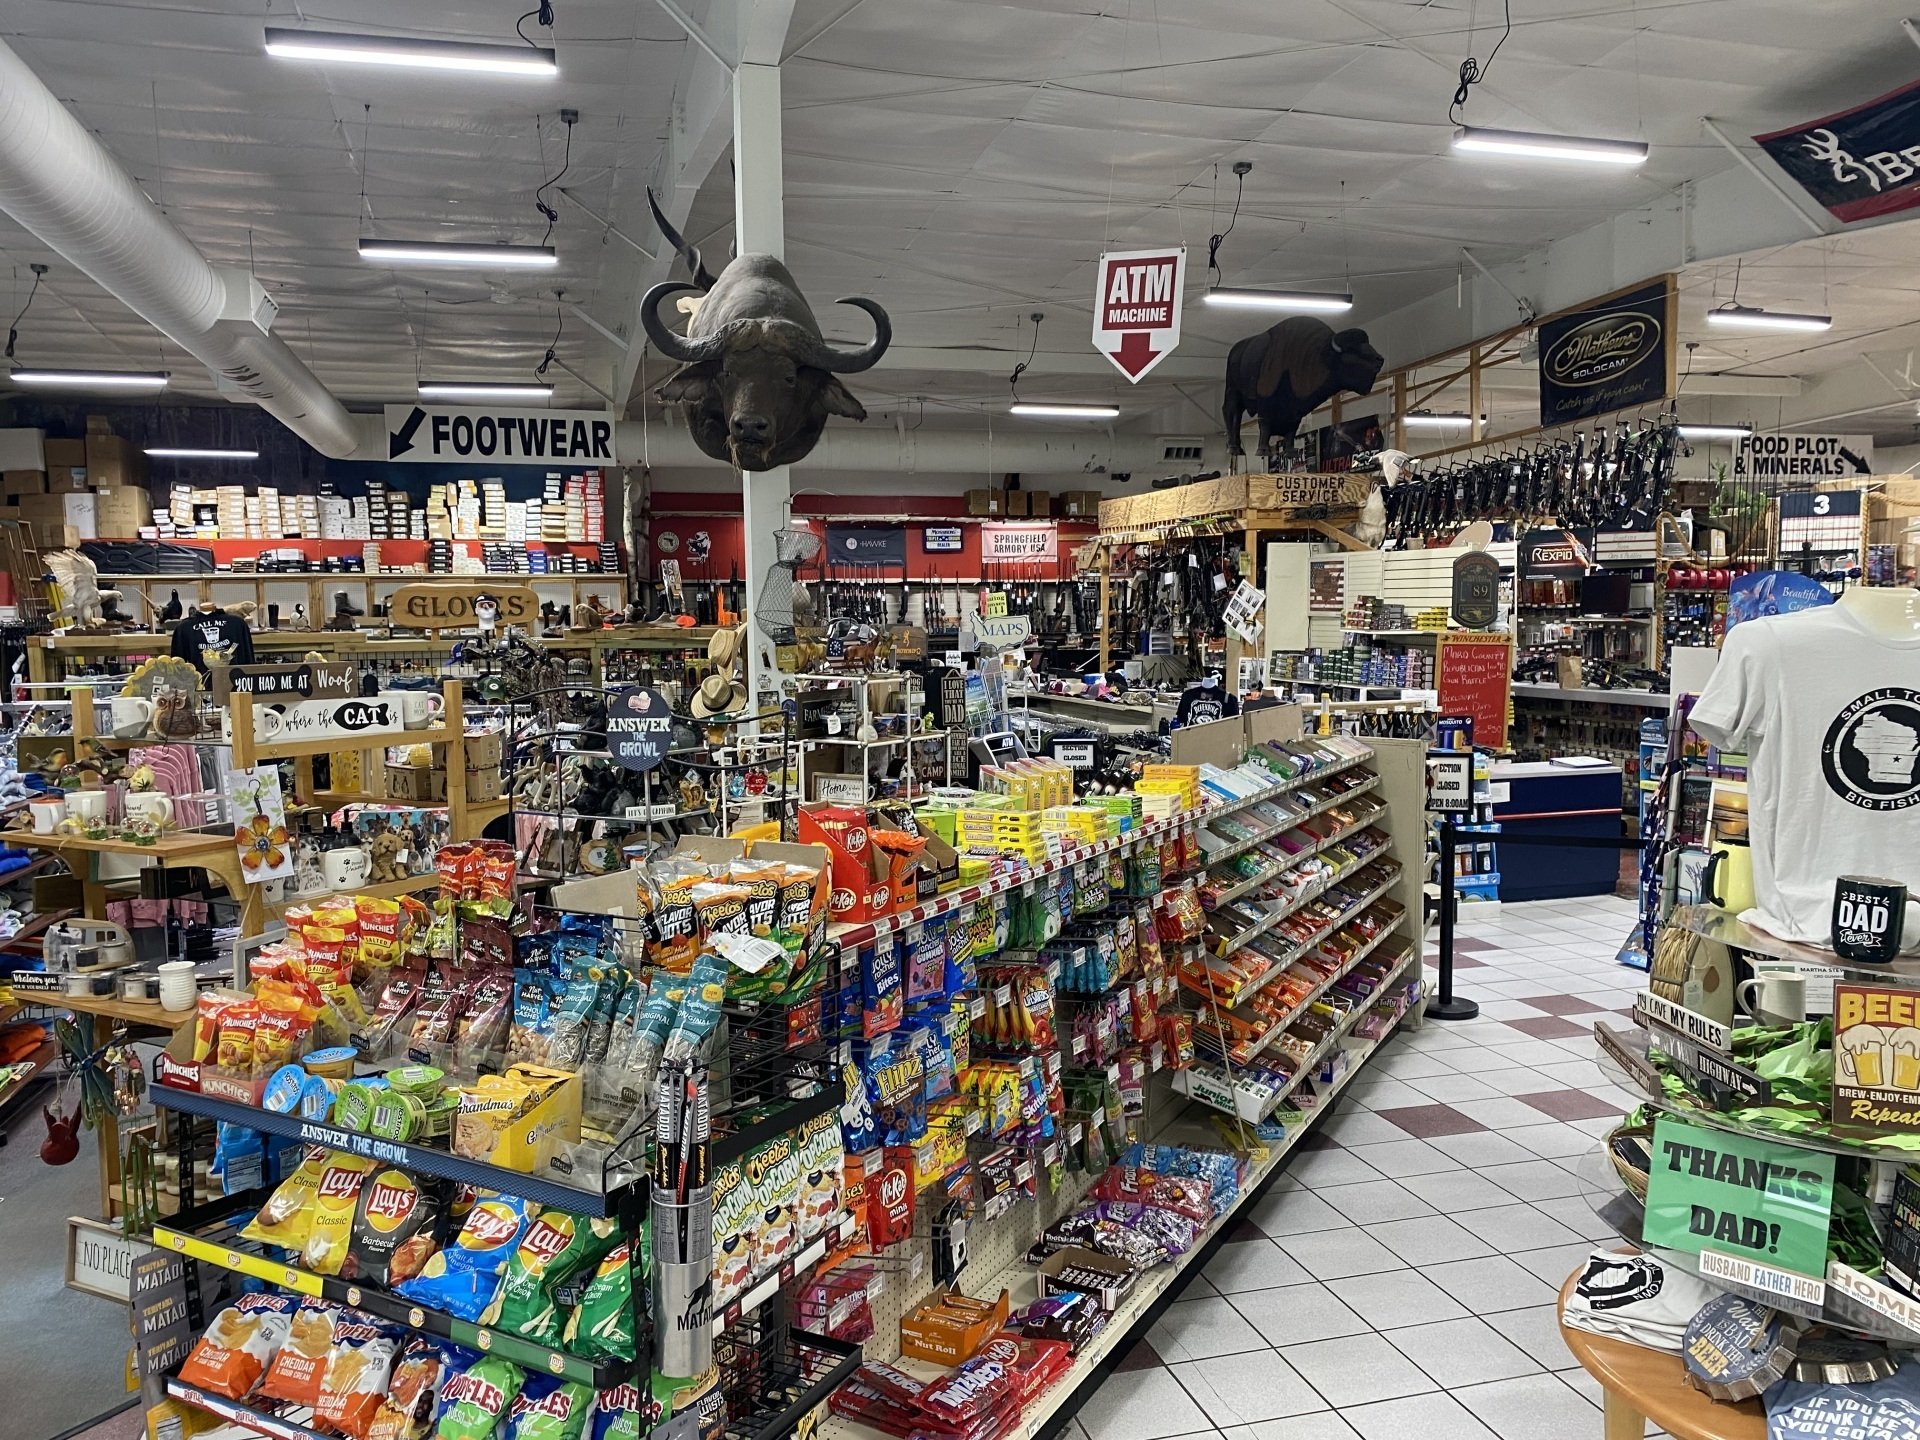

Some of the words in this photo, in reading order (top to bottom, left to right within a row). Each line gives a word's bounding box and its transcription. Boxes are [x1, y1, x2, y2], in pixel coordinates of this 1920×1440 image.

[1108, 264, 1172, 304] ATM
[1108, 305, 1168, 324] MACHINE
[1572, 358, 1626, 380] SOLOCAM
[1556, 396, 1581, 411] Catch
[431, 415, 612, 458] FOOTWEAR
[1740, 438, 1790, 456] FOOD
[1794, 438, 1838, 456] PLOT
[1734, 457, 1747, 475] &
[1753, 456, 1844, 475] MINERALS
[1276, 477, 1345, 490] CUSTOMER
[1282, 490, 1339, 502] SERVICE
[1814, 494, 1830, 515] 3
[994, 534, 1047, 544] SPRINGFIELD
[994, 545, 1027, 554] ARMORY
[1030, 543, 1045, 553] USA
[1532, 548, 1573, 562] REXPID
[1472, 584, 1488, 597] 89
[1782, 587, 1820, 603] Beautiful
[408, 596, 524, 617] GLOVS
[192, 621, 213, 630] CALL
[982, 623, 1024, 637] MAPS
[1452, 635, 1502, 643] WINCHESTER
[235, 677, 253, 692] YOU
[259, 676, 276, 691] HAD
[281, 675, 293, 690] ME
[298, 674, 308, 689] AT
[317, 666, 353, 693] Woof
[948, 680, 964, 689] LOVE
[944, 690, 964, 699] THAT
[944, 704, 965, 723] DAD
[1841, 689, 1896, 721] SMALL
[270, 712, 279, 729] is
[285, 710, 313, 732] where
[317, 709, 333, 727] the
[344, 707, 380, 725] CAT
[390, 710, 397, 723] is
[607, 717, 670, 733] ANSWER
[632, 732, 646, 742] THE
[1001, 738, 1014, 747] ATM
[620, 742, 660, 757] GROWL
[922, 766, 943, 778] CAMP
[1439, 764, 1461, 773] ECTION
[822, 781, 847, 796] Home
[1845, 791, 1873, 808] BIG
[1083, 890, 1101, 901] ALL
[1084, 894, 1104, 907] STAR
[1850, 892, 1880, 905] BEST
[661, 907, 692, 923] FLAVOR
[700, 901, 743, 927] Cheetos
[1838, 901, 1889, 933] DAD
[360, 921, 394, 934] MUNCHIES
[661, 919, 692, 941] HOTS
[968, 919, 993, 938] PATCH
[366, 937, 390, 946] SALTED
[1847, 933, 1870, 944] ever
[307, 949, 338, 963] MUNCHIES
[871, 950, 893, 972] JOLLY
[308, 965, 332, 973] SALTED
[13, 973, 43, 984] Whatever
[44, 977, 56, 986] you
[876, 974, 899, 995] Bites
[475, 993, 499, 1001] HARVEST
[222, 1016, 257, 1030] MUNCHIES
[260, 1012, 291, 1031] MUNCHIES
[640, 1011, 670, 1026] ORIGINAL
[1637, 992, 1648, 1011] MY
[1650, 998, 1667, 1020] CAVE
[1671, 1007, 1685, 1029] MY
[1689, 1016, 1721, 1047] RULES
[164, 1057, 199, 1082] MUNCHIES
[875, 1057, 923, 1099] Flipz
[1700, 1054, 1742, 1091] HIGHWAY
[202, 1080, 250, 1104] MUNCHIES
[895, 1083, 920, 1101] Chocolate
[1193, 1084, 1234, 1104] Junior
[1870, 1092, 1900, 1103] ENJOY
[457, 1098, 513, 1115] Grandma's
[660, 1085, 671, 1140] MATADOR
[697, 1084, 708, 1140] MATADOR
[1851, 1100, 1920, 1126] Repeat
[301, 1123, 349, 1147] ANSWER
[351, 1135, 372, 1154] THE
[373, 1139, 409, 1163] GROWL
[751, 1141, 790, 1184] Cheetos
[1663, 1141, 1823, 1204] THANKS
[369, 1185, 418, 1220] Lay's
[890, 1205, 908, 1217] minis
[316, 1215, 348, 1227] Classic
[464, 1207, 517, 1243] Lay's
[1689, 1204, 1781, 1255] DAD!
[362, 1235, 395, 1248] Barbecue
[84, 1242, 100, 1268] NO
[103, 1245, 131, 1279] PLACE
[448, 1255, 475, 1272] Vinegar
[453, 1250, 466, 1262] Salt
[137, 1257, 167, 1275] TERIYAKI
[1704, 1257, 1751, 1283] HUSBAND
[1754, 1268, 1791, 1293] FATHER
[1795, 1279, 1821, 1302] HERO
[236, 1292, 289, 1312] RUFFLES
[1832, 1267, 1920, 1326] HOME
[142, 1298, 173, 1317] TERIYAKI
[1851, 1289, 1874, 1307] where
[1876, 1304, 1888, 1316] my
[1890, 1310, 1905, 1324] dad
[1727, 1300, 1761, 1336] Wate
[1716, 1320, 1730, 1330] IS
[1724, 1323, 1752, 1349] BAD
[914, 1340, 932, 1352] Nut
[935, 1342, 956, 1355] Roll
[1700, 1323, 1729, 1351] DRINK
[1724, 1344, 1745, 1366] THE
[280, 1356, 316, 1375] CHEDDAR
[1688, 1336, 1729, 1377] BEER
[282, 1369, 294, 1379] SOUR
[295, 1371, 311, 1381] CREAM
[929, 1362, 1003, 1407] Twizzlers
[441, 1372, 504, 1416] RUFFLES
[447, 1405, 464, 1425] QUESO
[1808, 1397, 1829, 1408] IF
[1835, 1399, 1873, 1415] YOU
[236, 1411, 257, 1425] RUFFLES
[612, 1416, 632, 1433] QUESO
[1793, 1407, 1856, 1426] THINK
[1786, 1418, 1828, 1434] YOU
